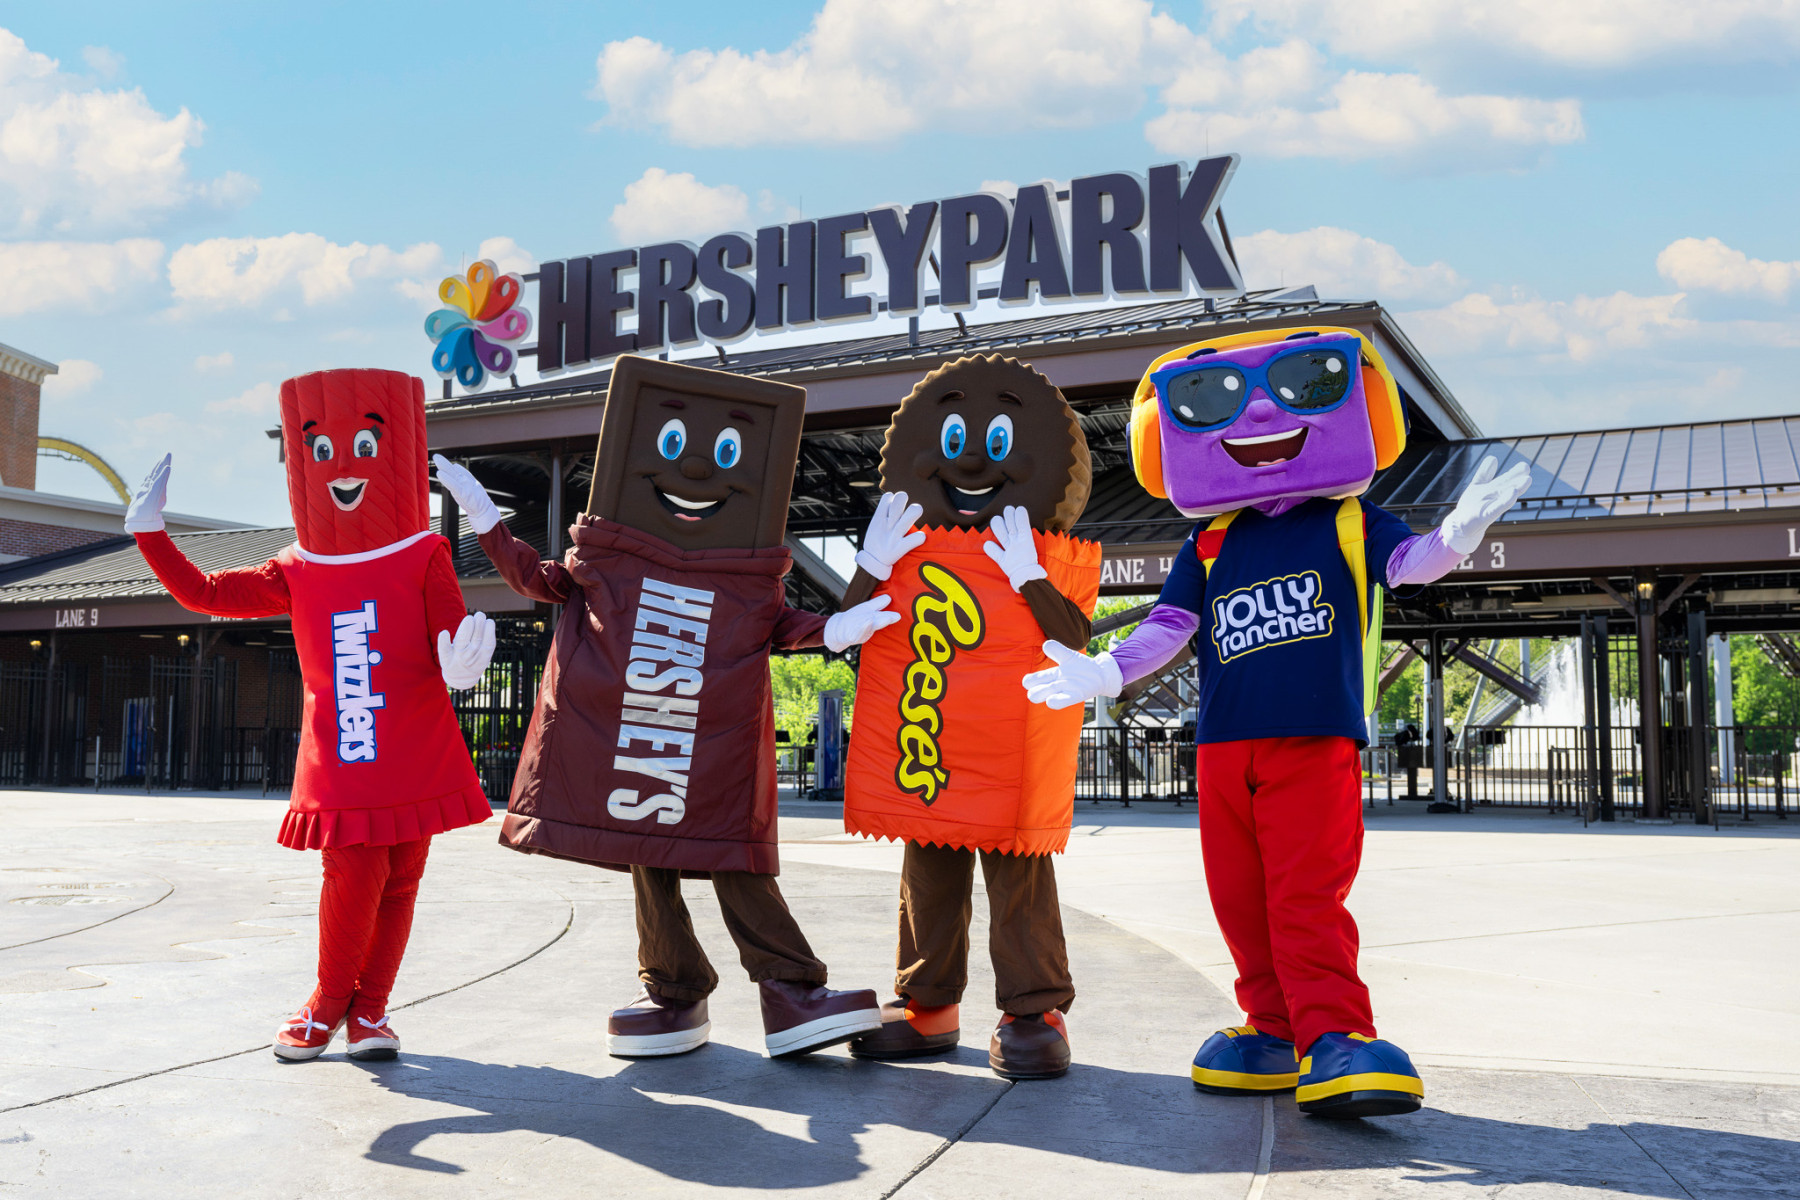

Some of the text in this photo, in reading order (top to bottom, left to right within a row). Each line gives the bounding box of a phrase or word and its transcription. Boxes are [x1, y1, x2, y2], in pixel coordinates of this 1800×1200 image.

[537, 154, 1243, 373] HERSHEYPARK
[1099, 558, 1145, 584] ANE
[1490, 541, 1506, 569] 3
[55, 608, 99, 628] LANE 9
[1215, 576, 1315, 639] JOLLY
[1221, 609, 1328, 657] rancher
[332, 600, 386, 763] Twizzlers
[606, 577, 716, 826] HERSHEY'S
[897, 563, 983, 804] Reese's
